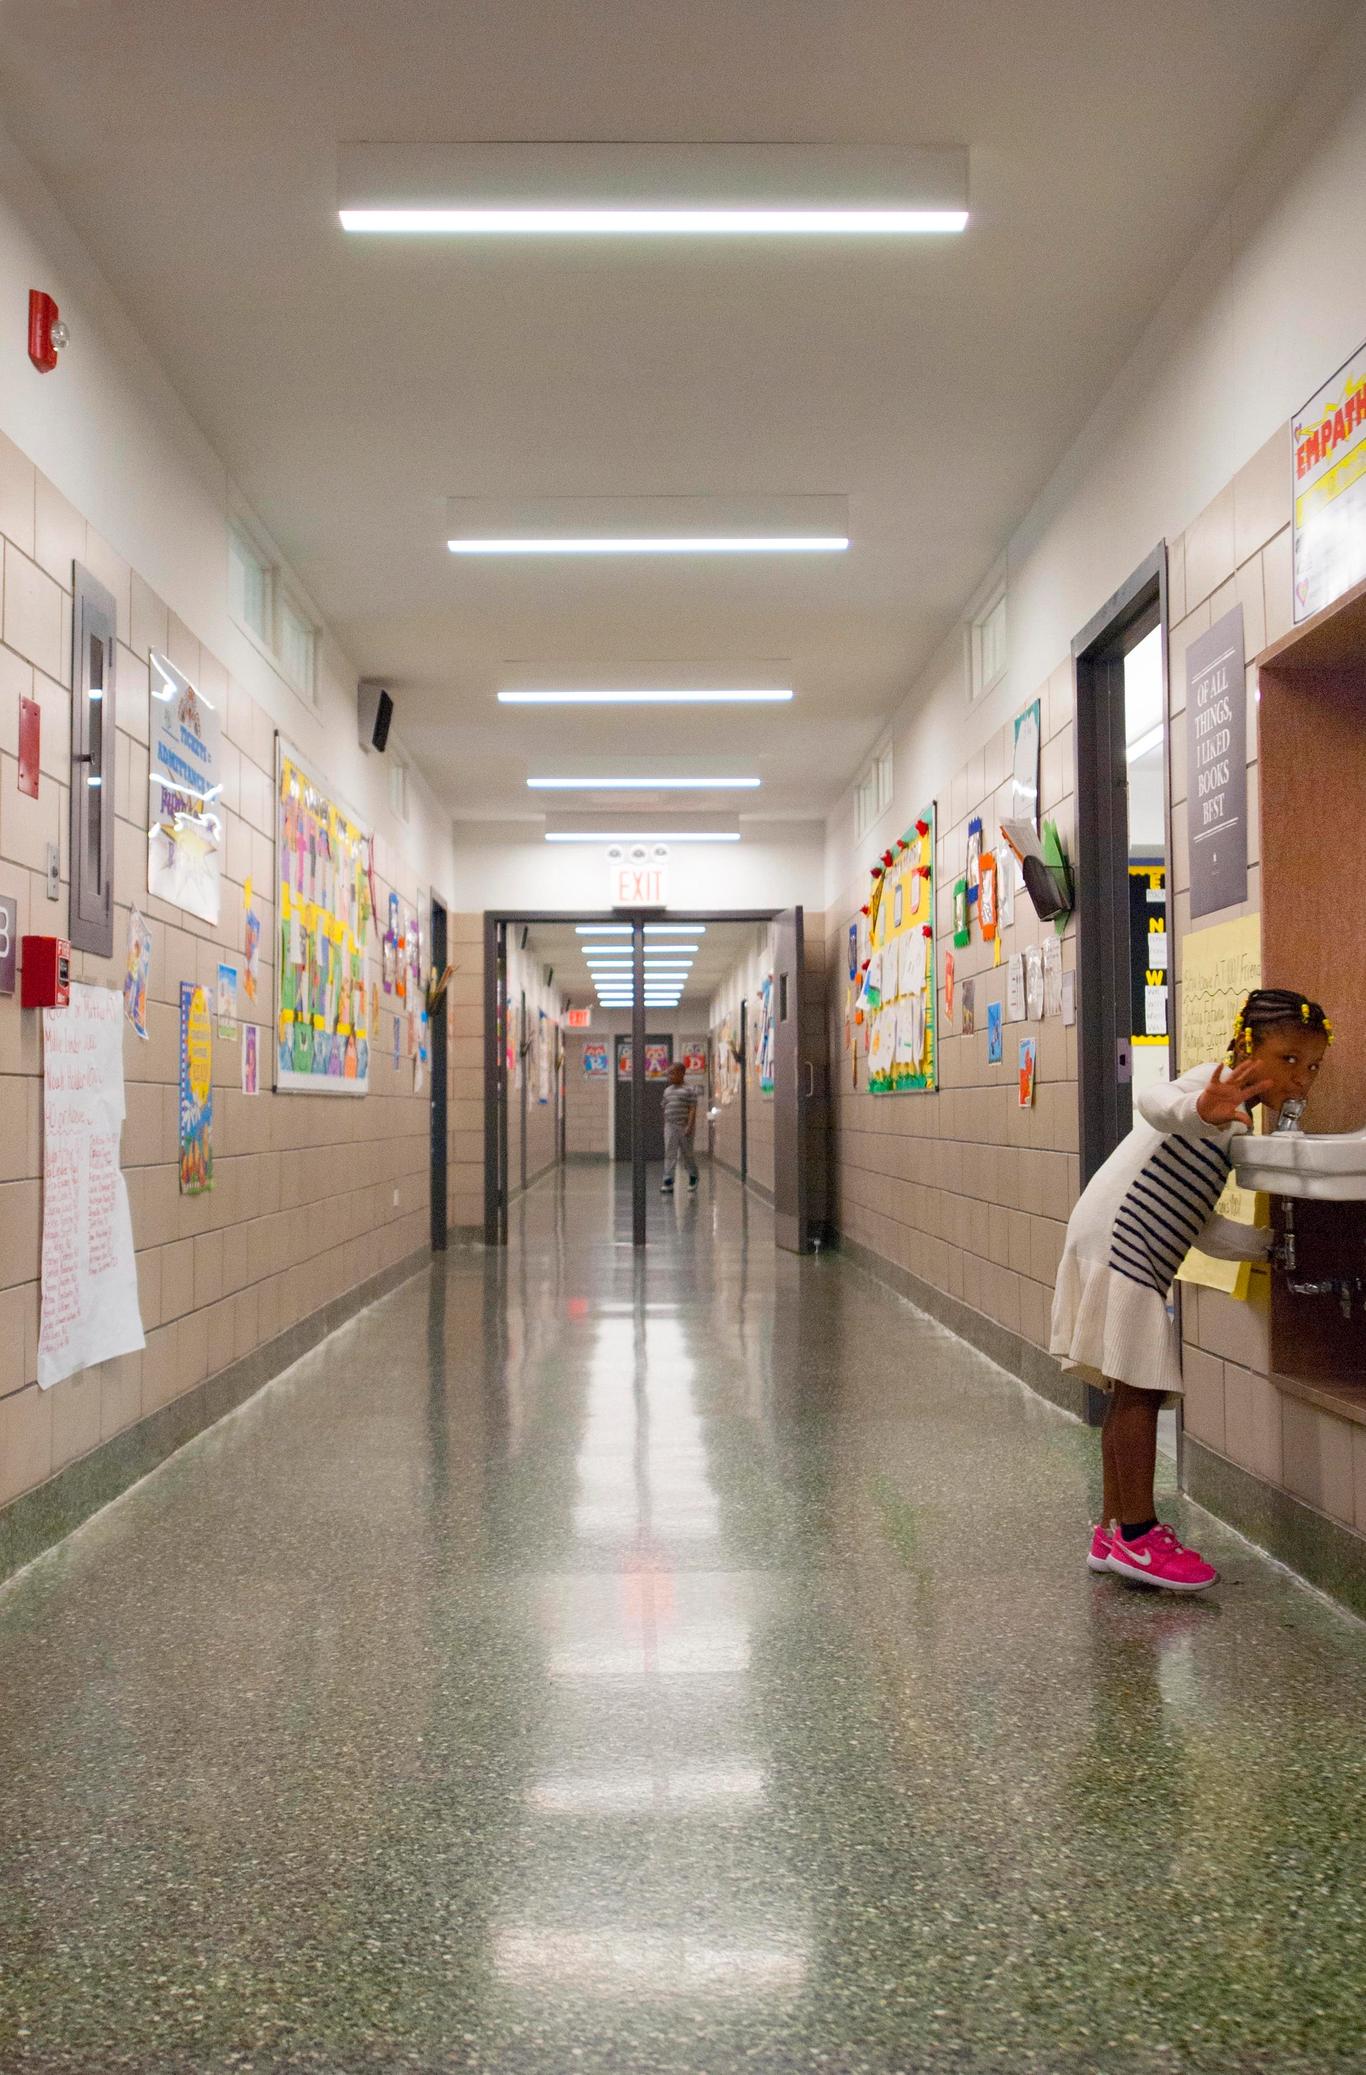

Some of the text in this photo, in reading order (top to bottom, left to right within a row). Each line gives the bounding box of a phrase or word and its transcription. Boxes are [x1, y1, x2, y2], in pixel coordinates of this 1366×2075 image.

[1197, 667, 1229, 706] OF ALL
[1194, 696, 1233, 739] THINGS,
[1202, 728, 1231, 765] LIKED
[1198, 759, 1230, 797] BOOKS
[1203, 793, 1225, 825] BEST
[618, 870, 663, 902] EXIT
[1150, 873, 1161, 890] E
[1149, 917, 1164, 934] N
[1145, 969, 1164, 987] W
[568, 1010, 588, 1026] EXIT
[590, 1055, 602, 1069] R
[690, 1055, 701, 1070] D
